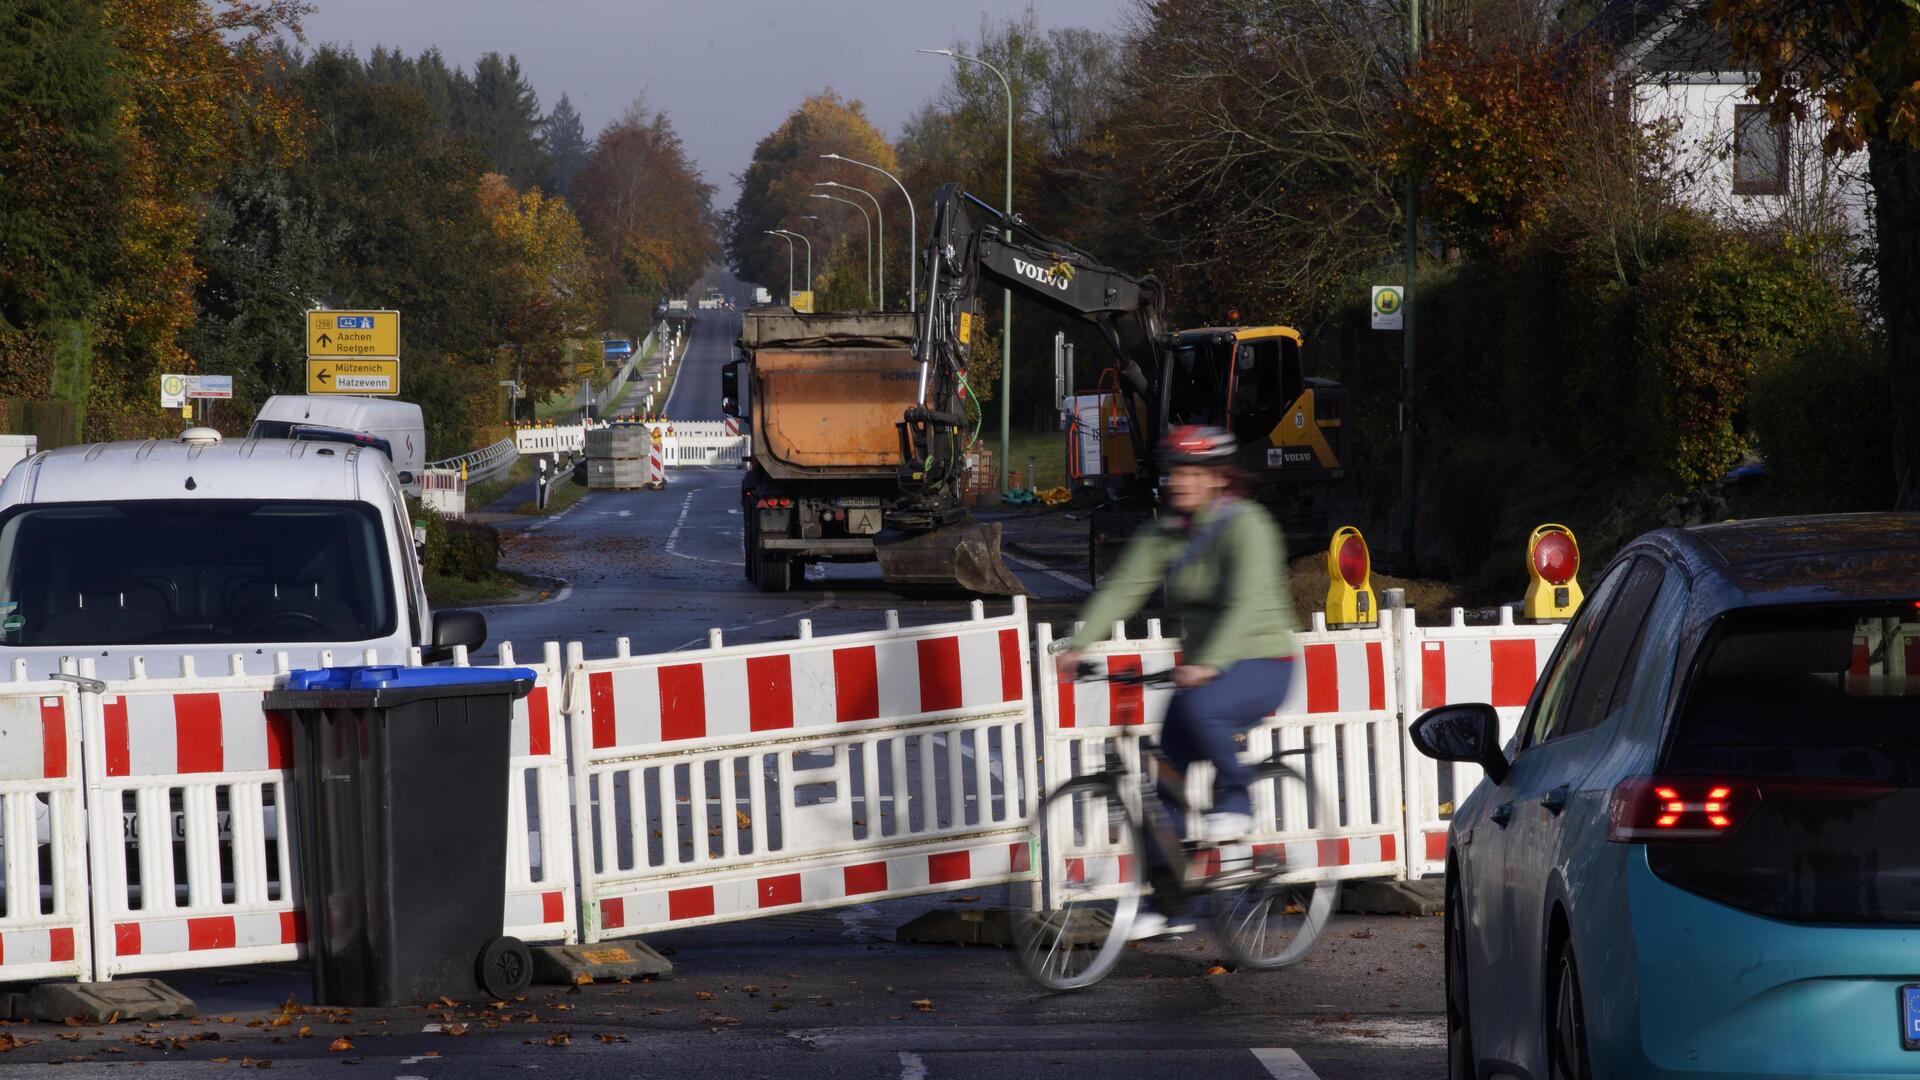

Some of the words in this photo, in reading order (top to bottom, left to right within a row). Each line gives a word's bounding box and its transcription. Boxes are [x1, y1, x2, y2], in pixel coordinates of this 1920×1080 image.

[1013, 258, 1069, 290] VOLVO
[337, 332, 372, 341] Aachen
[336, 344, 375, 354] Roetgen
[335, 363, 383, 372] Mützenich
[880, 371, 918, 381] SCHM
[338, 378, 387, 387] Hatzevenn
[1284, 453, 1311, 462] VOLVO
[857, 511, 874, 530] A
